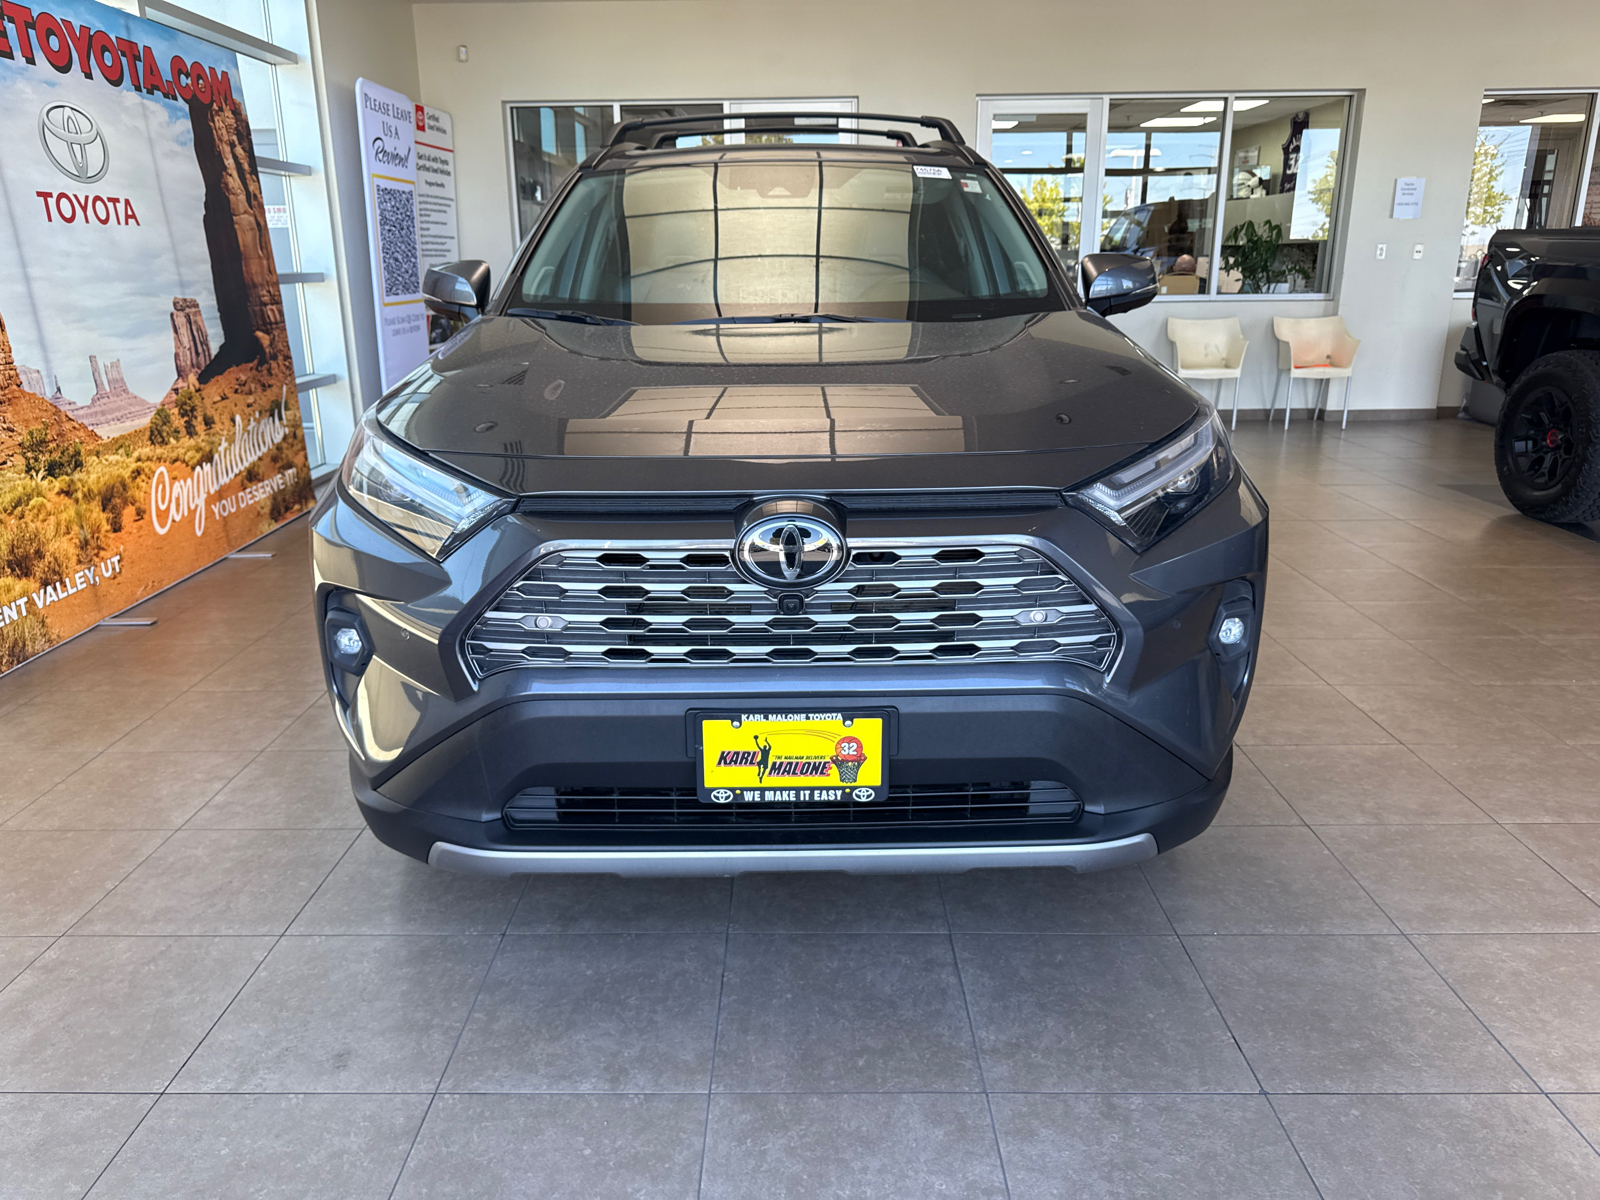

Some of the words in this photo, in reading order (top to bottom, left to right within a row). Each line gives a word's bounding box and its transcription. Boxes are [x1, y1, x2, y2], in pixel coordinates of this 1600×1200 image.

[364, 92, 391, 117] PLEASE
[392, 103, 412, 124] LEAVE
[394, 125, 400, 140] A
[372, 136, 411, 169] Review!
[35, 190, 141, 226] TOYOTA
[151, 384, 289, 537] Congratulations!
[211, 494, 237, 520] YOU
[237, 473, 285, 509] DESERVE
[285, 467, 298, 487] IT!
[31, 565, 100, 610] VALLEY,
[100, 554, 121, 578] UT
[741, 714, 766, 722] KARL
[768, 713, 806, 721] MALONE
[716, 750, 760, 767] KARL
[840, 742, 858, 755] 32
[767, 760, 832, 777] MALONE
[743, 791, 761, 801] WE
[765, 790, 796, 801] MAKE
[800, 790, 810, 801] IT
[813, 790, 842, 801] EASY
